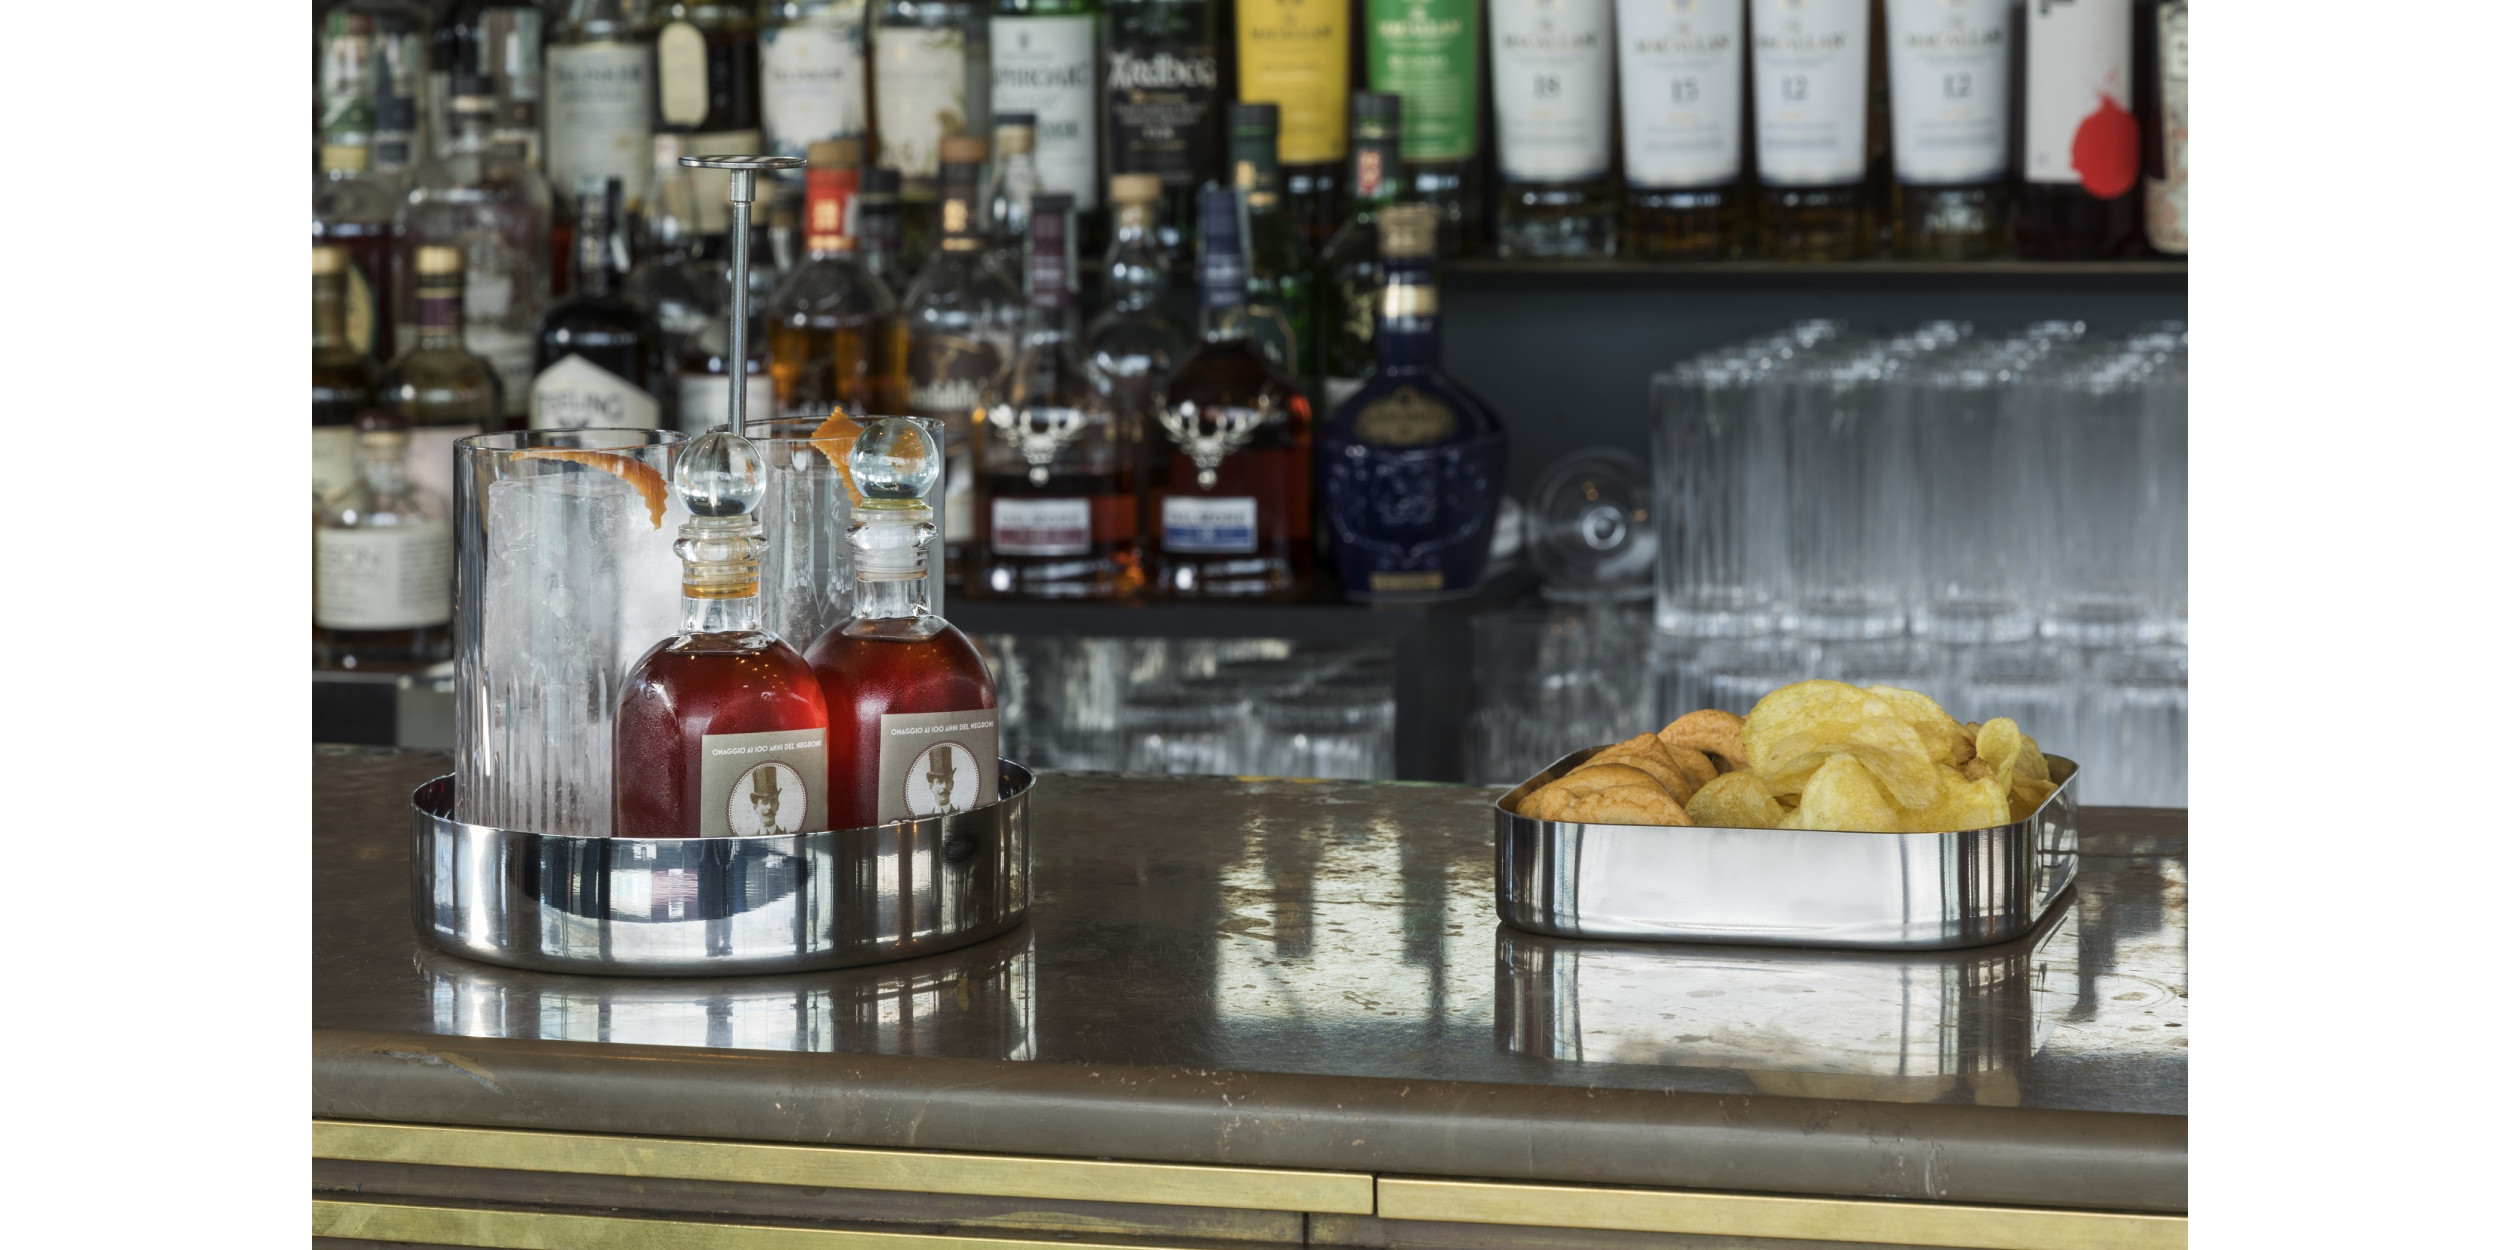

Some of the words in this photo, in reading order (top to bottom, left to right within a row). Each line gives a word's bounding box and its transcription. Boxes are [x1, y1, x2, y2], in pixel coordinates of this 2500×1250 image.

[1670, 77, 1699, 104] 15
[1781, 75, 1809, 101] 12
[1943, 72, 1973, 99] 12
[890, 727, 923, 736] OMAGGIO
[924, 726, 930, 734] AI
[945, 724, 958, 732] ANNI
[959, 722, 969, 731] DEL
[970, 720, 994, 729] NEGRONI
[712, 747, 746, 756] OMAGGIO
[747, 746, 754, 754] AI
[769, 744, 783, 752] ANNI
[784, 742, 795, 751] DEL
[796, 739, 822, 749] NEGRONI
